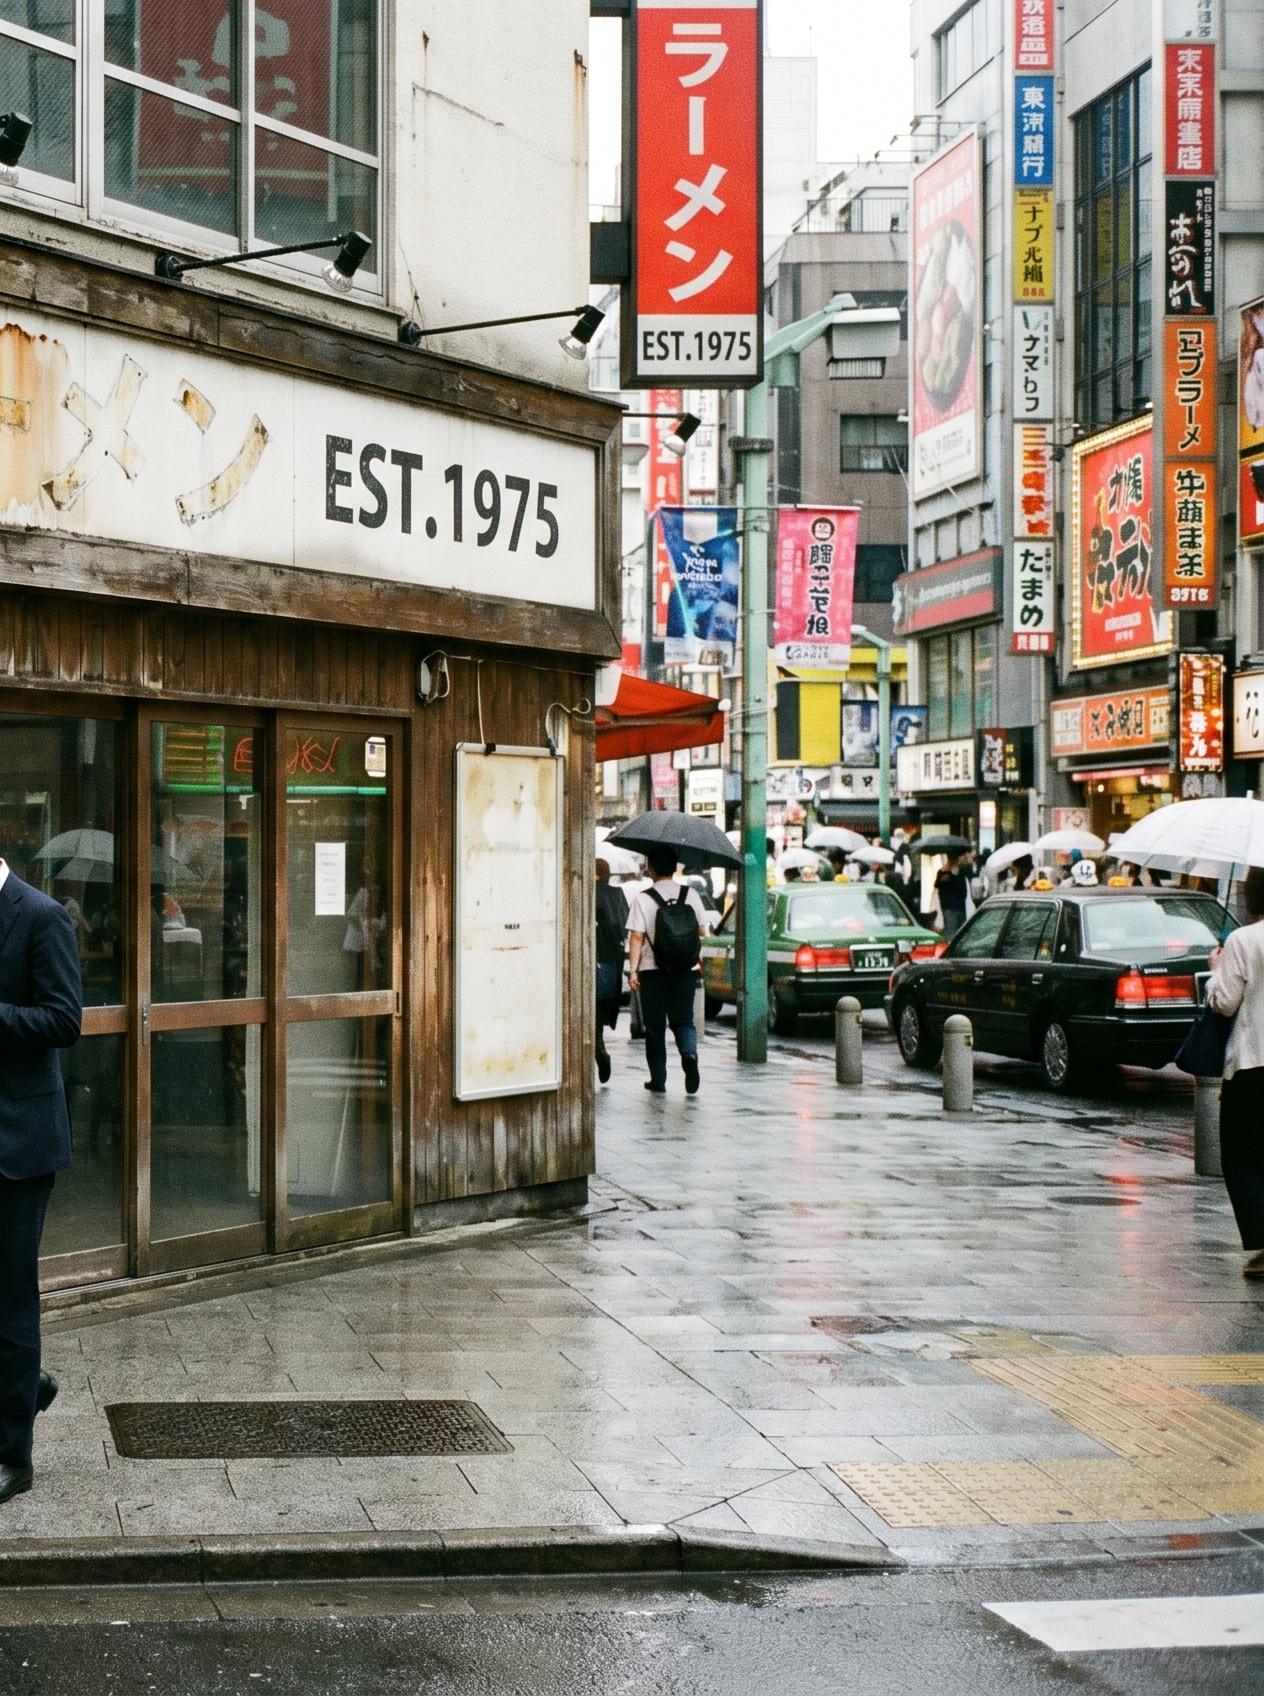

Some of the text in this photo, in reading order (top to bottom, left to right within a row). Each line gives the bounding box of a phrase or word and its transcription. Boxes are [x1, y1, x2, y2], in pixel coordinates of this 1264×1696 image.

[663, 23, 733, 302] ラーメン
[642, 331, 751, 361] EST.1975
[325, 434, 559, 558] EST.1975
[1020, 549, 1044, 628] たまめ
